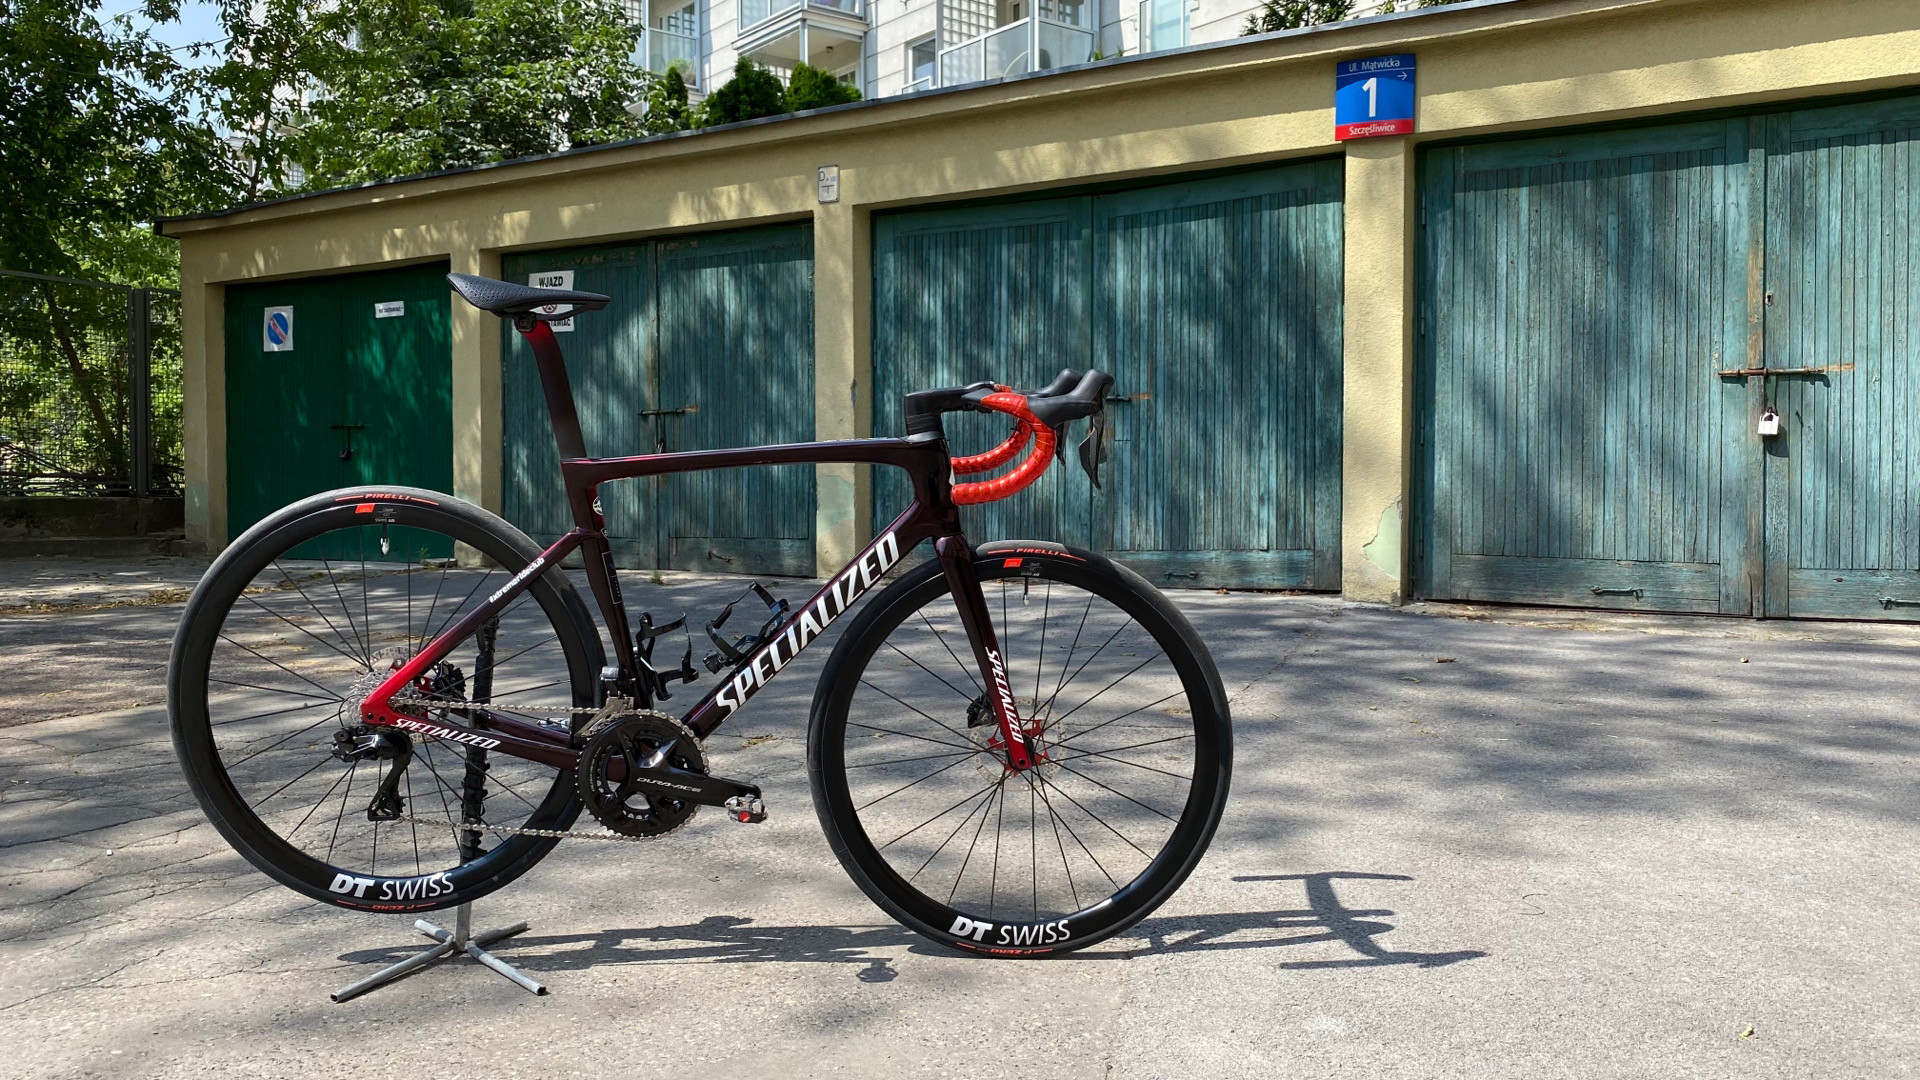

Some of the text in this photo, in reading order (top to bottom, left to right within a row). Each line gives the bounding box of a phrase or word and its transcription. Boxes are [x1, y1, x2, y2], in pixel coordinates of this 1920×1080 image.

[1361, 58, 1400, 71] Mątwicka
[1362, 77, 1377, 117] 1
[1349, 123, 1395, 135] Szczęśliwice
[539, 276, 563, 287] WJAZD
[716, 531, 900, 722] SPECIALIZED
[985, 646, 1025, 744] SPECIALIZED
[390, 718, 501, 749] SPECIALIZED
[636, 777, 702, 793] DURA-ACE
[329, 872, 455, 900] DT SWISS
[949, 915, 1071, 946] DT SWISS
